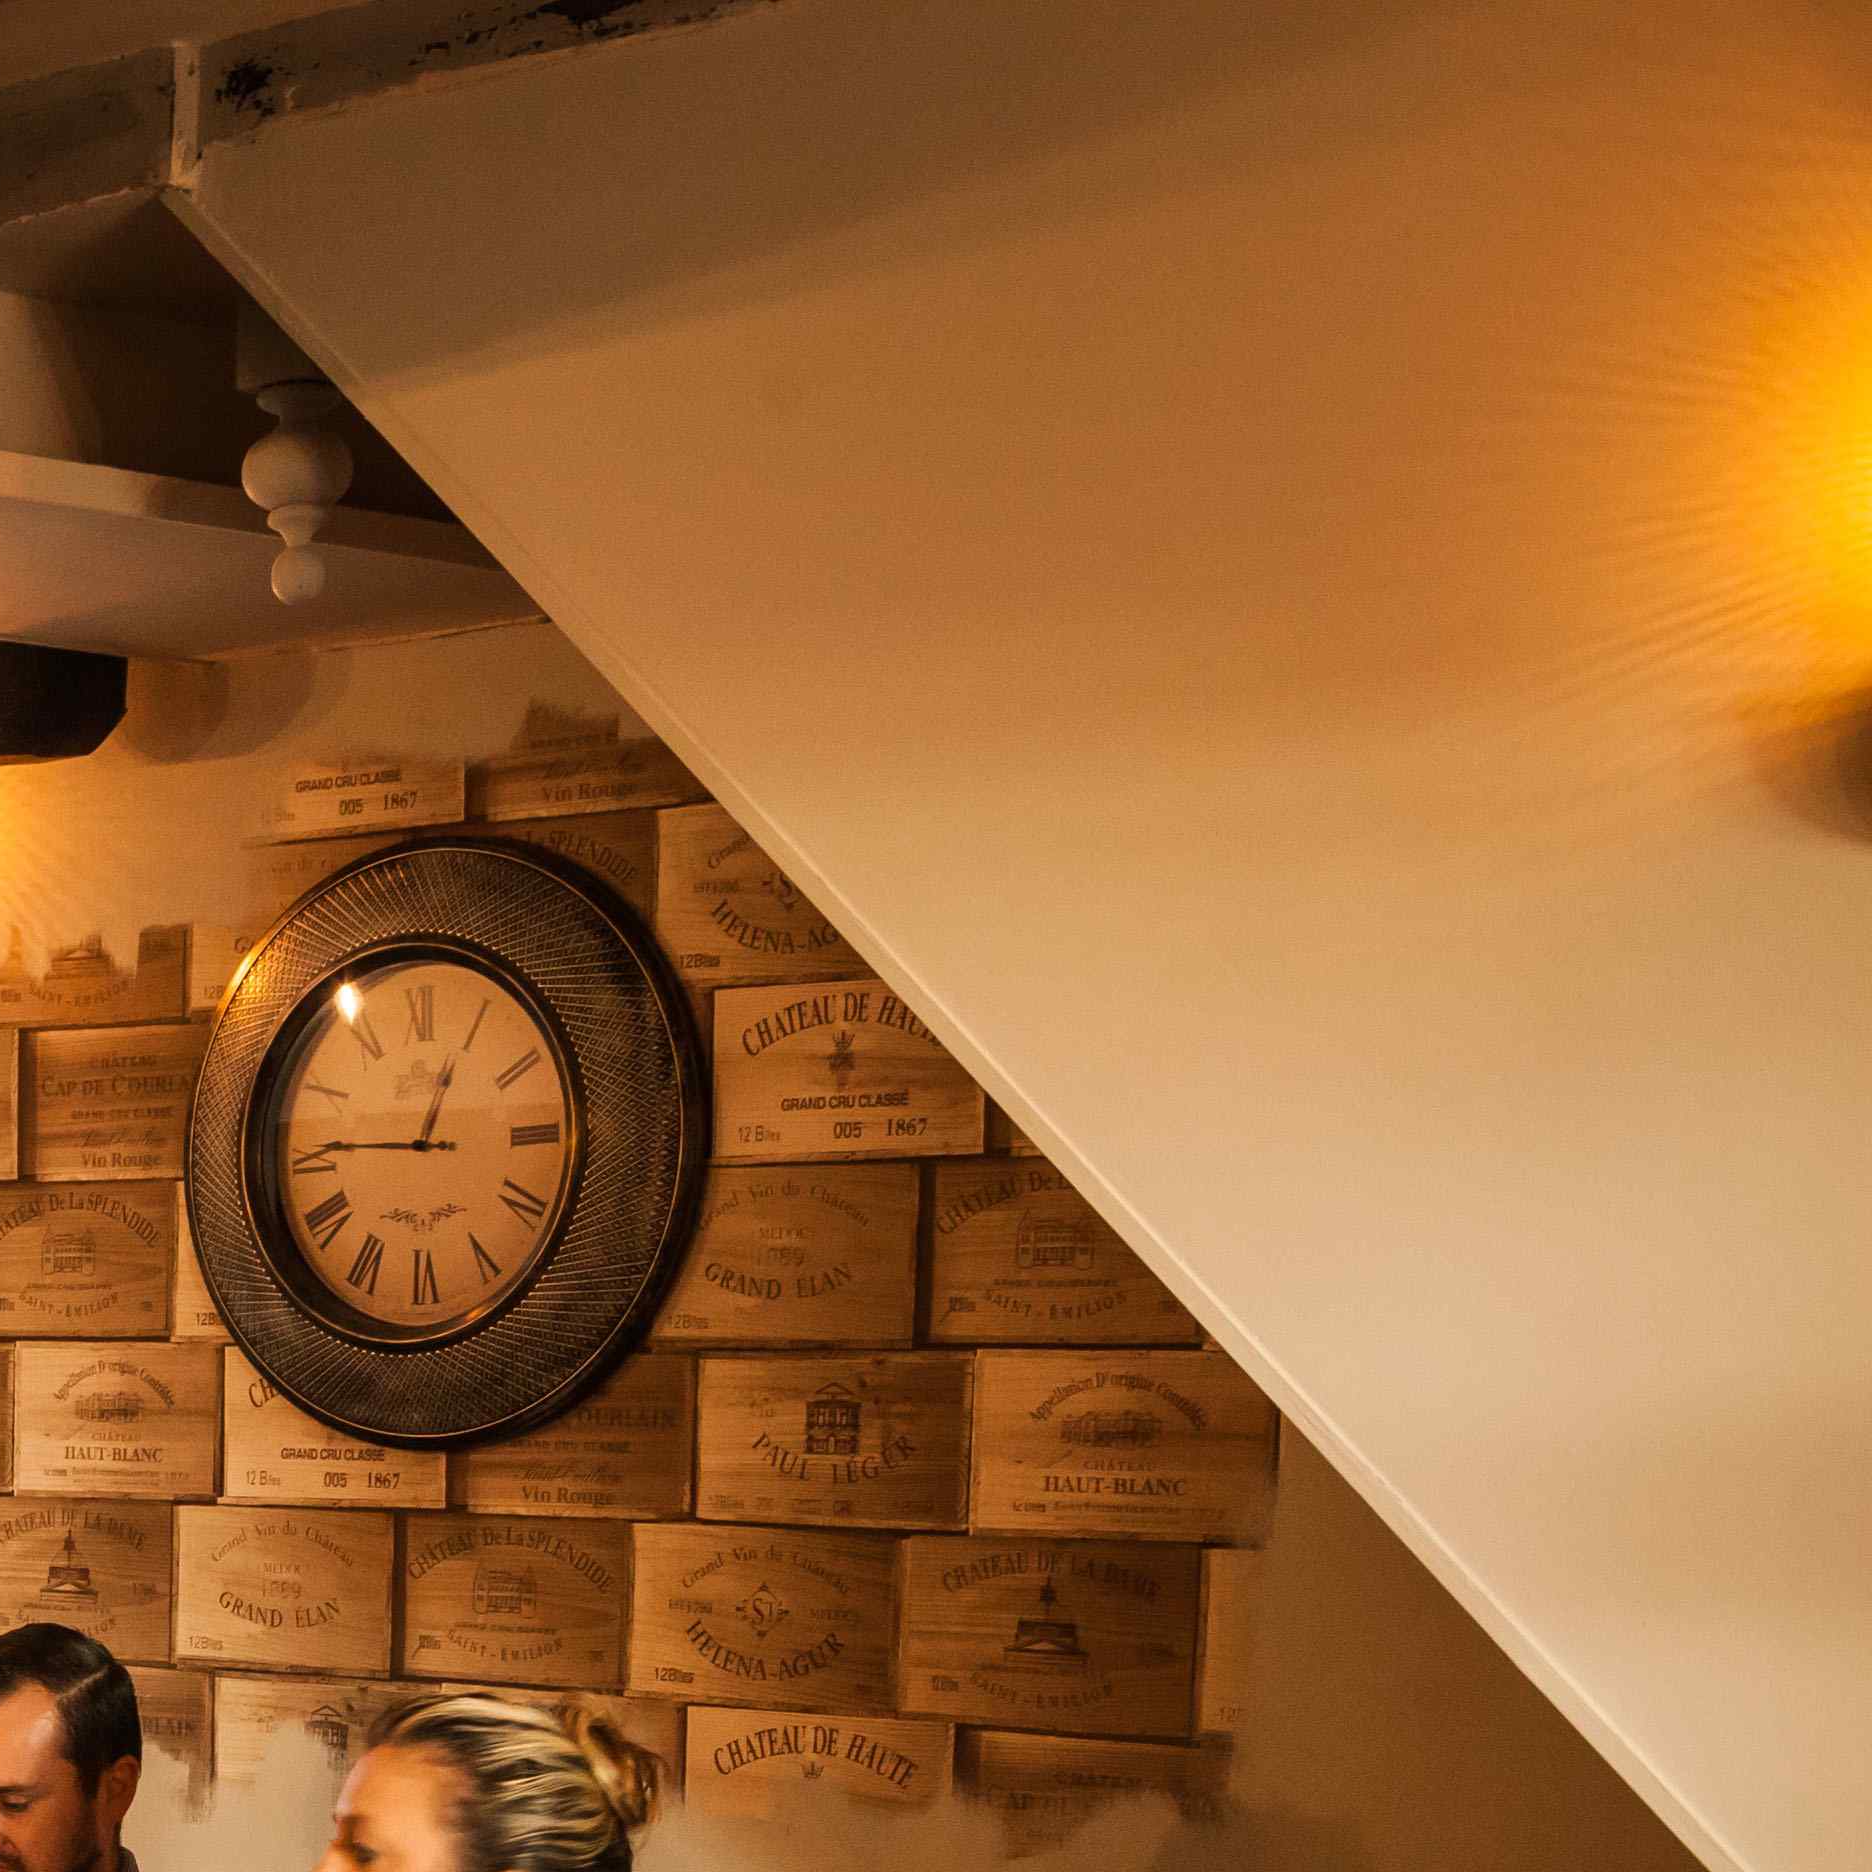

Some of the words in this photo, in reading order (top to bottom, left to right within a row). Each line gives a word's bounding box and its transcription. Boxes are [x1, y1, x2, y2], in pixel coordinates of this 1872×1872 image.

[296, 777, 333, 793] GRAND
[335, 774, 357, 788] CRU
[339, 798, 366, 816] 005
[383, 791, 419, 811] 1867
[407, 985, 435, 1045] XII
[464, 999, 490, 1051] I
[842, 991, 871, 1024] DE
[495, 1047, 540, 1091] II
[306, 1073, 350, 1115] X
[781, 1098, 826, 1112] GRAND
[828, 1096, 855, 1110] CRU
[511, 1121, 560, 1148] III
[832, 1121, 864, 1139] 005
[885, 1116, 929, 1138] 1867
[81, 1152, 106, 1169] Vin
[111, 1150, 161, 1172] Rouge
[48, 1192, 65, 1212] De
[68, 1191, 84, 1210] La
[86, 1191, 162, 1249] SPLENDIDE
[304, 1190, 353, 1250] VIII
[346, 1232, 384, 1296] VII
[412, 1249, 440, 1305] VI
[468, 1232, 503, 1285] V
[705, 1261, 782, 1300] GRAND
[64, 1445, 164, 1464] HAUT-BLANC
[281, 1447, 317, 1460] GRAND
[319, 1447, 342, 1460] CRU
[752, 1432, 810, 1481] PAUL
[323, 1470, 348, 1487] 005
[368, 1471, 401, 1489] 1867
[521, 1485, 552, 1503] Vin
[556, 1486, 613, 1509] Rouge
[1043, 1475, 1187, 1497] HAUT-BLANC
[211, 1527, 248, 1563] Grand
[255, 1523, 276, 1538] Vin
[482, 1526, 504, 1548] De
[506, 1525, 526, 1546] La
[527, 1529, 615, 1596] SPLENDIDE
[681, 1552, 725, 1590] Grand
[732, 1546, 757, 1561] Vin
[218, 1590, 283, 1629] GRAND
[686, 1618, 846, 1682] HELENA-AGUR
[713, 1725, 808, 1776] CHATEAU
[812, 1725, 841, 1757] DE
[846, 1733, 921, 1790] HAUTE
